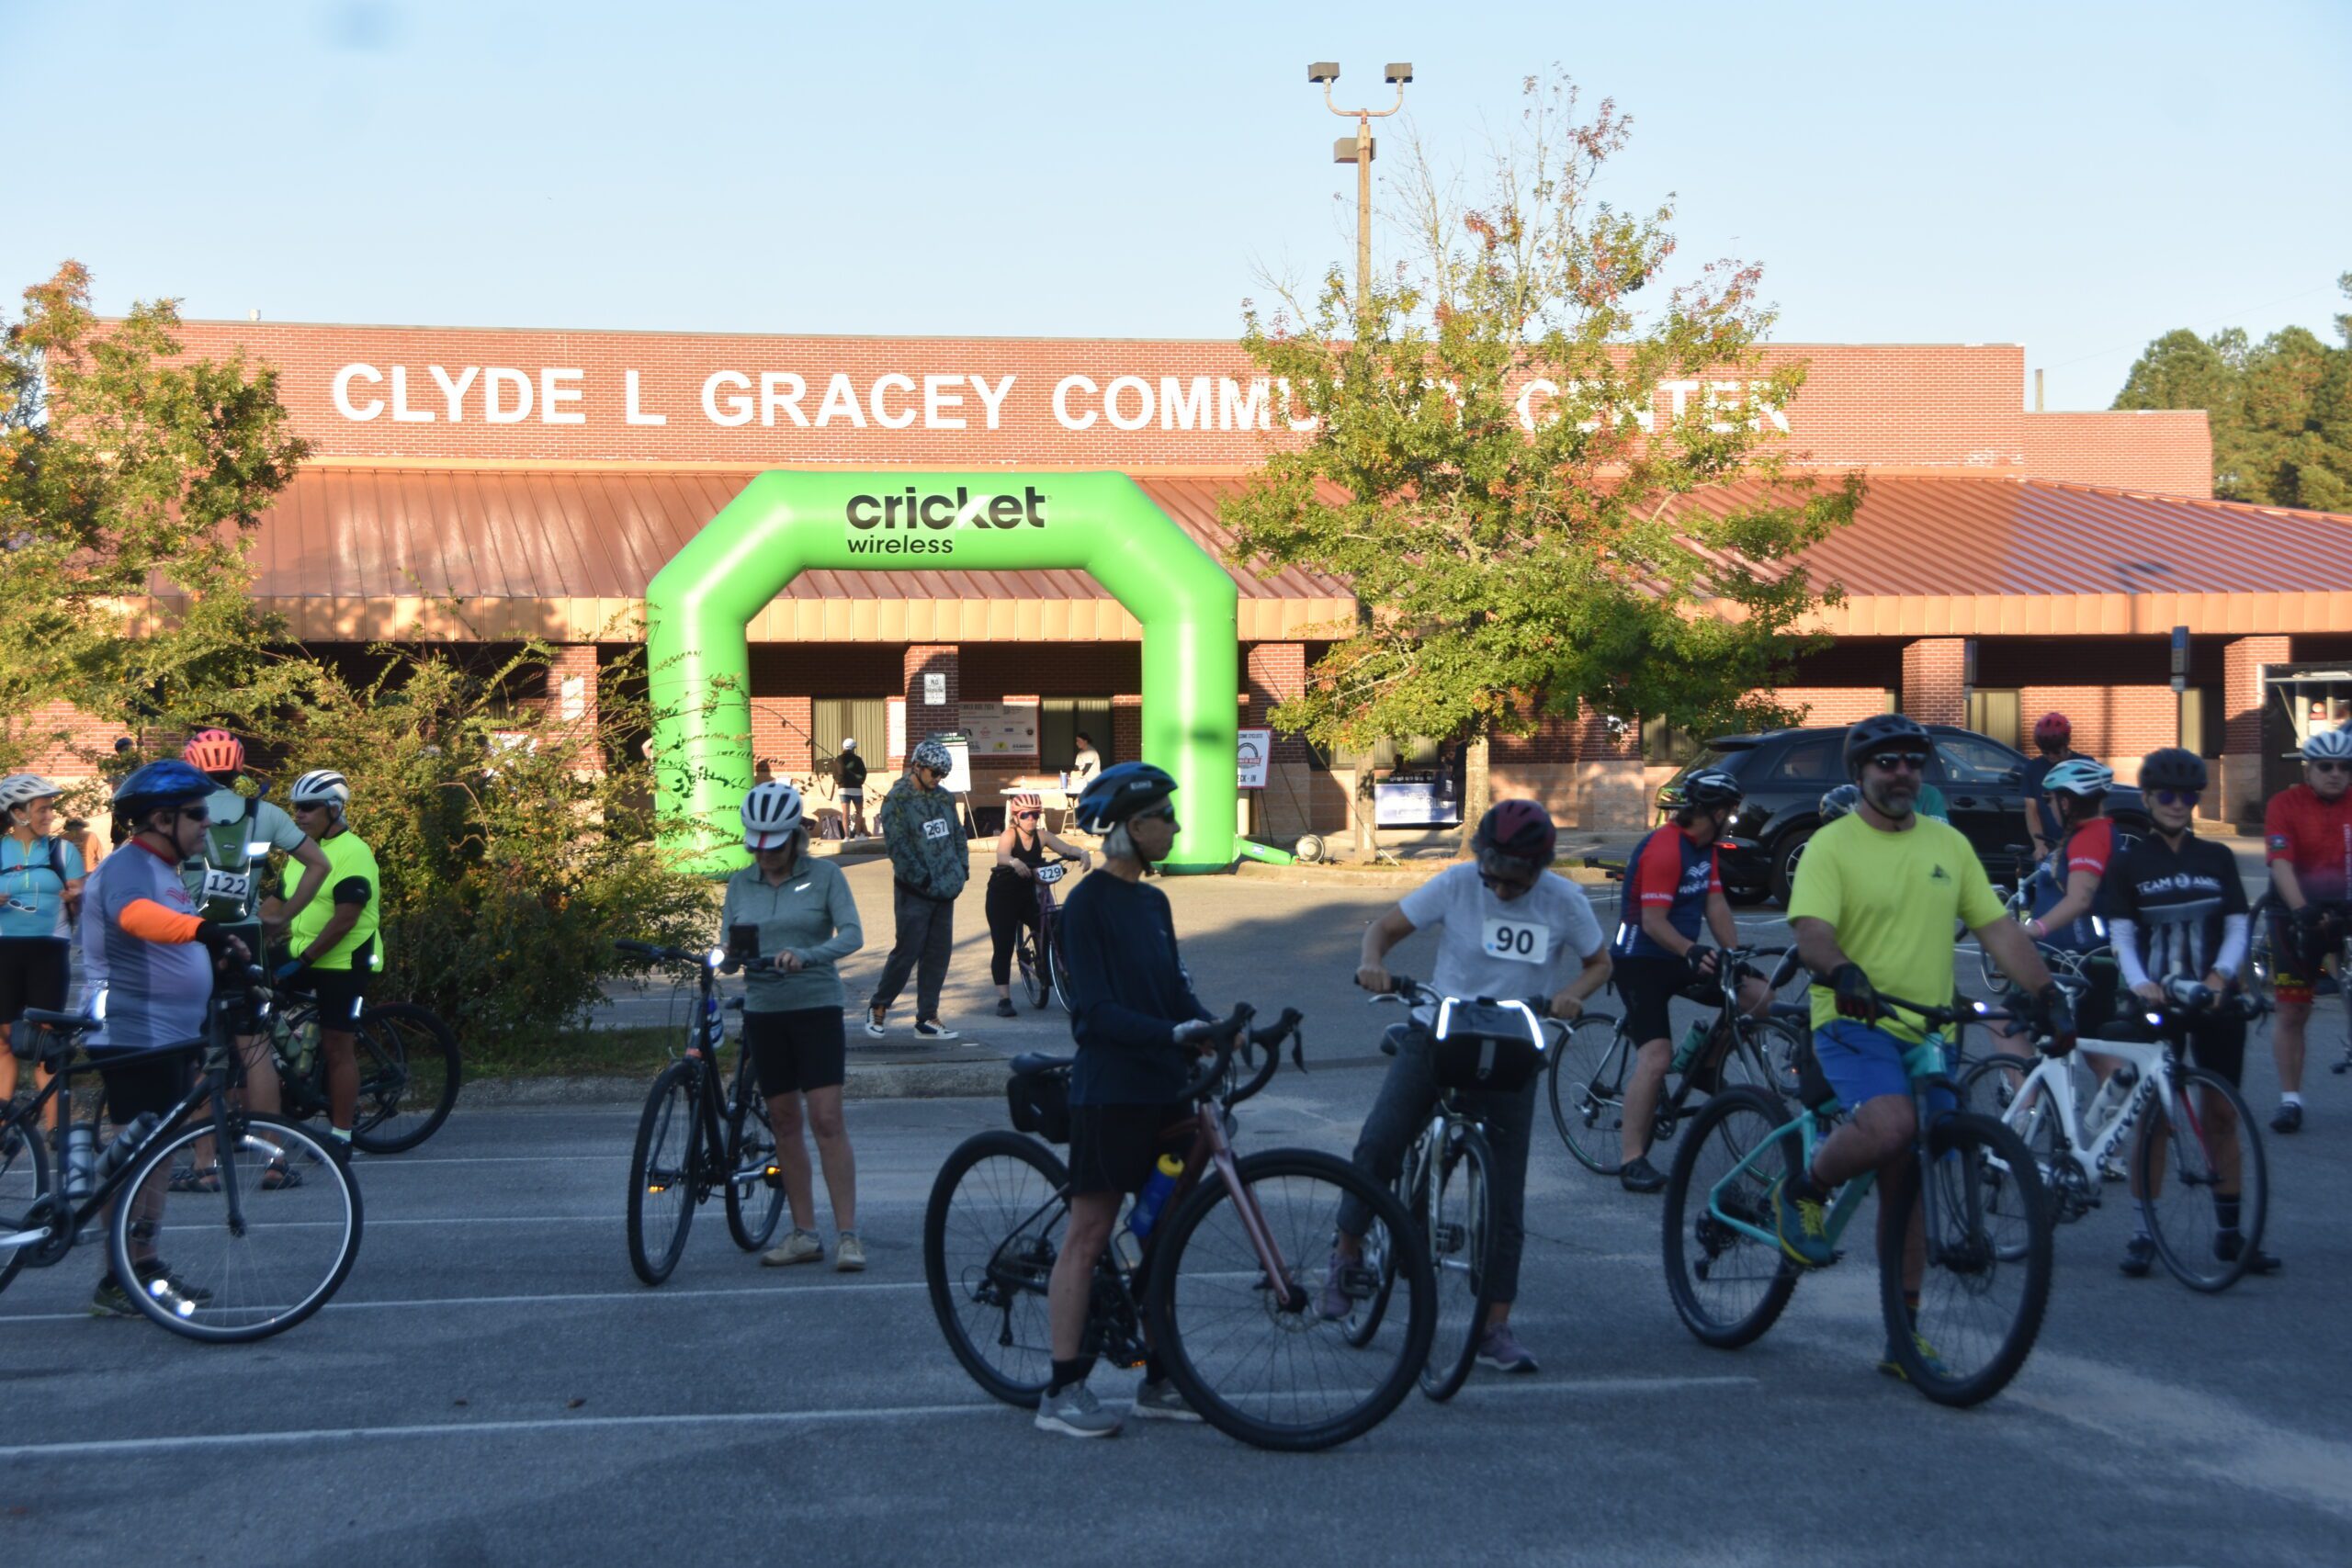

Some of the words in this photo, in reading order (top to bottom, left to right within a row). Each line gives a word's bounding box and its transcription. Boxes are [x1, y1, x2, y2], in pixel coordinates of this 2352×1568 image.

[332, 363, 585, 424] CLYDE
[626, 369, 667, 425] L
[701, 370, 1017, 430] GRACEY
[1052, 375, 1481, 433] COMMU
[846, 486, 1046, 530] cricket
[847, 535, 954, 554] wireless
[925, 820, 945, 836] 267
[1039, 867, 1061, 880] 229
[208, 874, 246, 897] 122
[1496, 926, 1534, 955] 90
